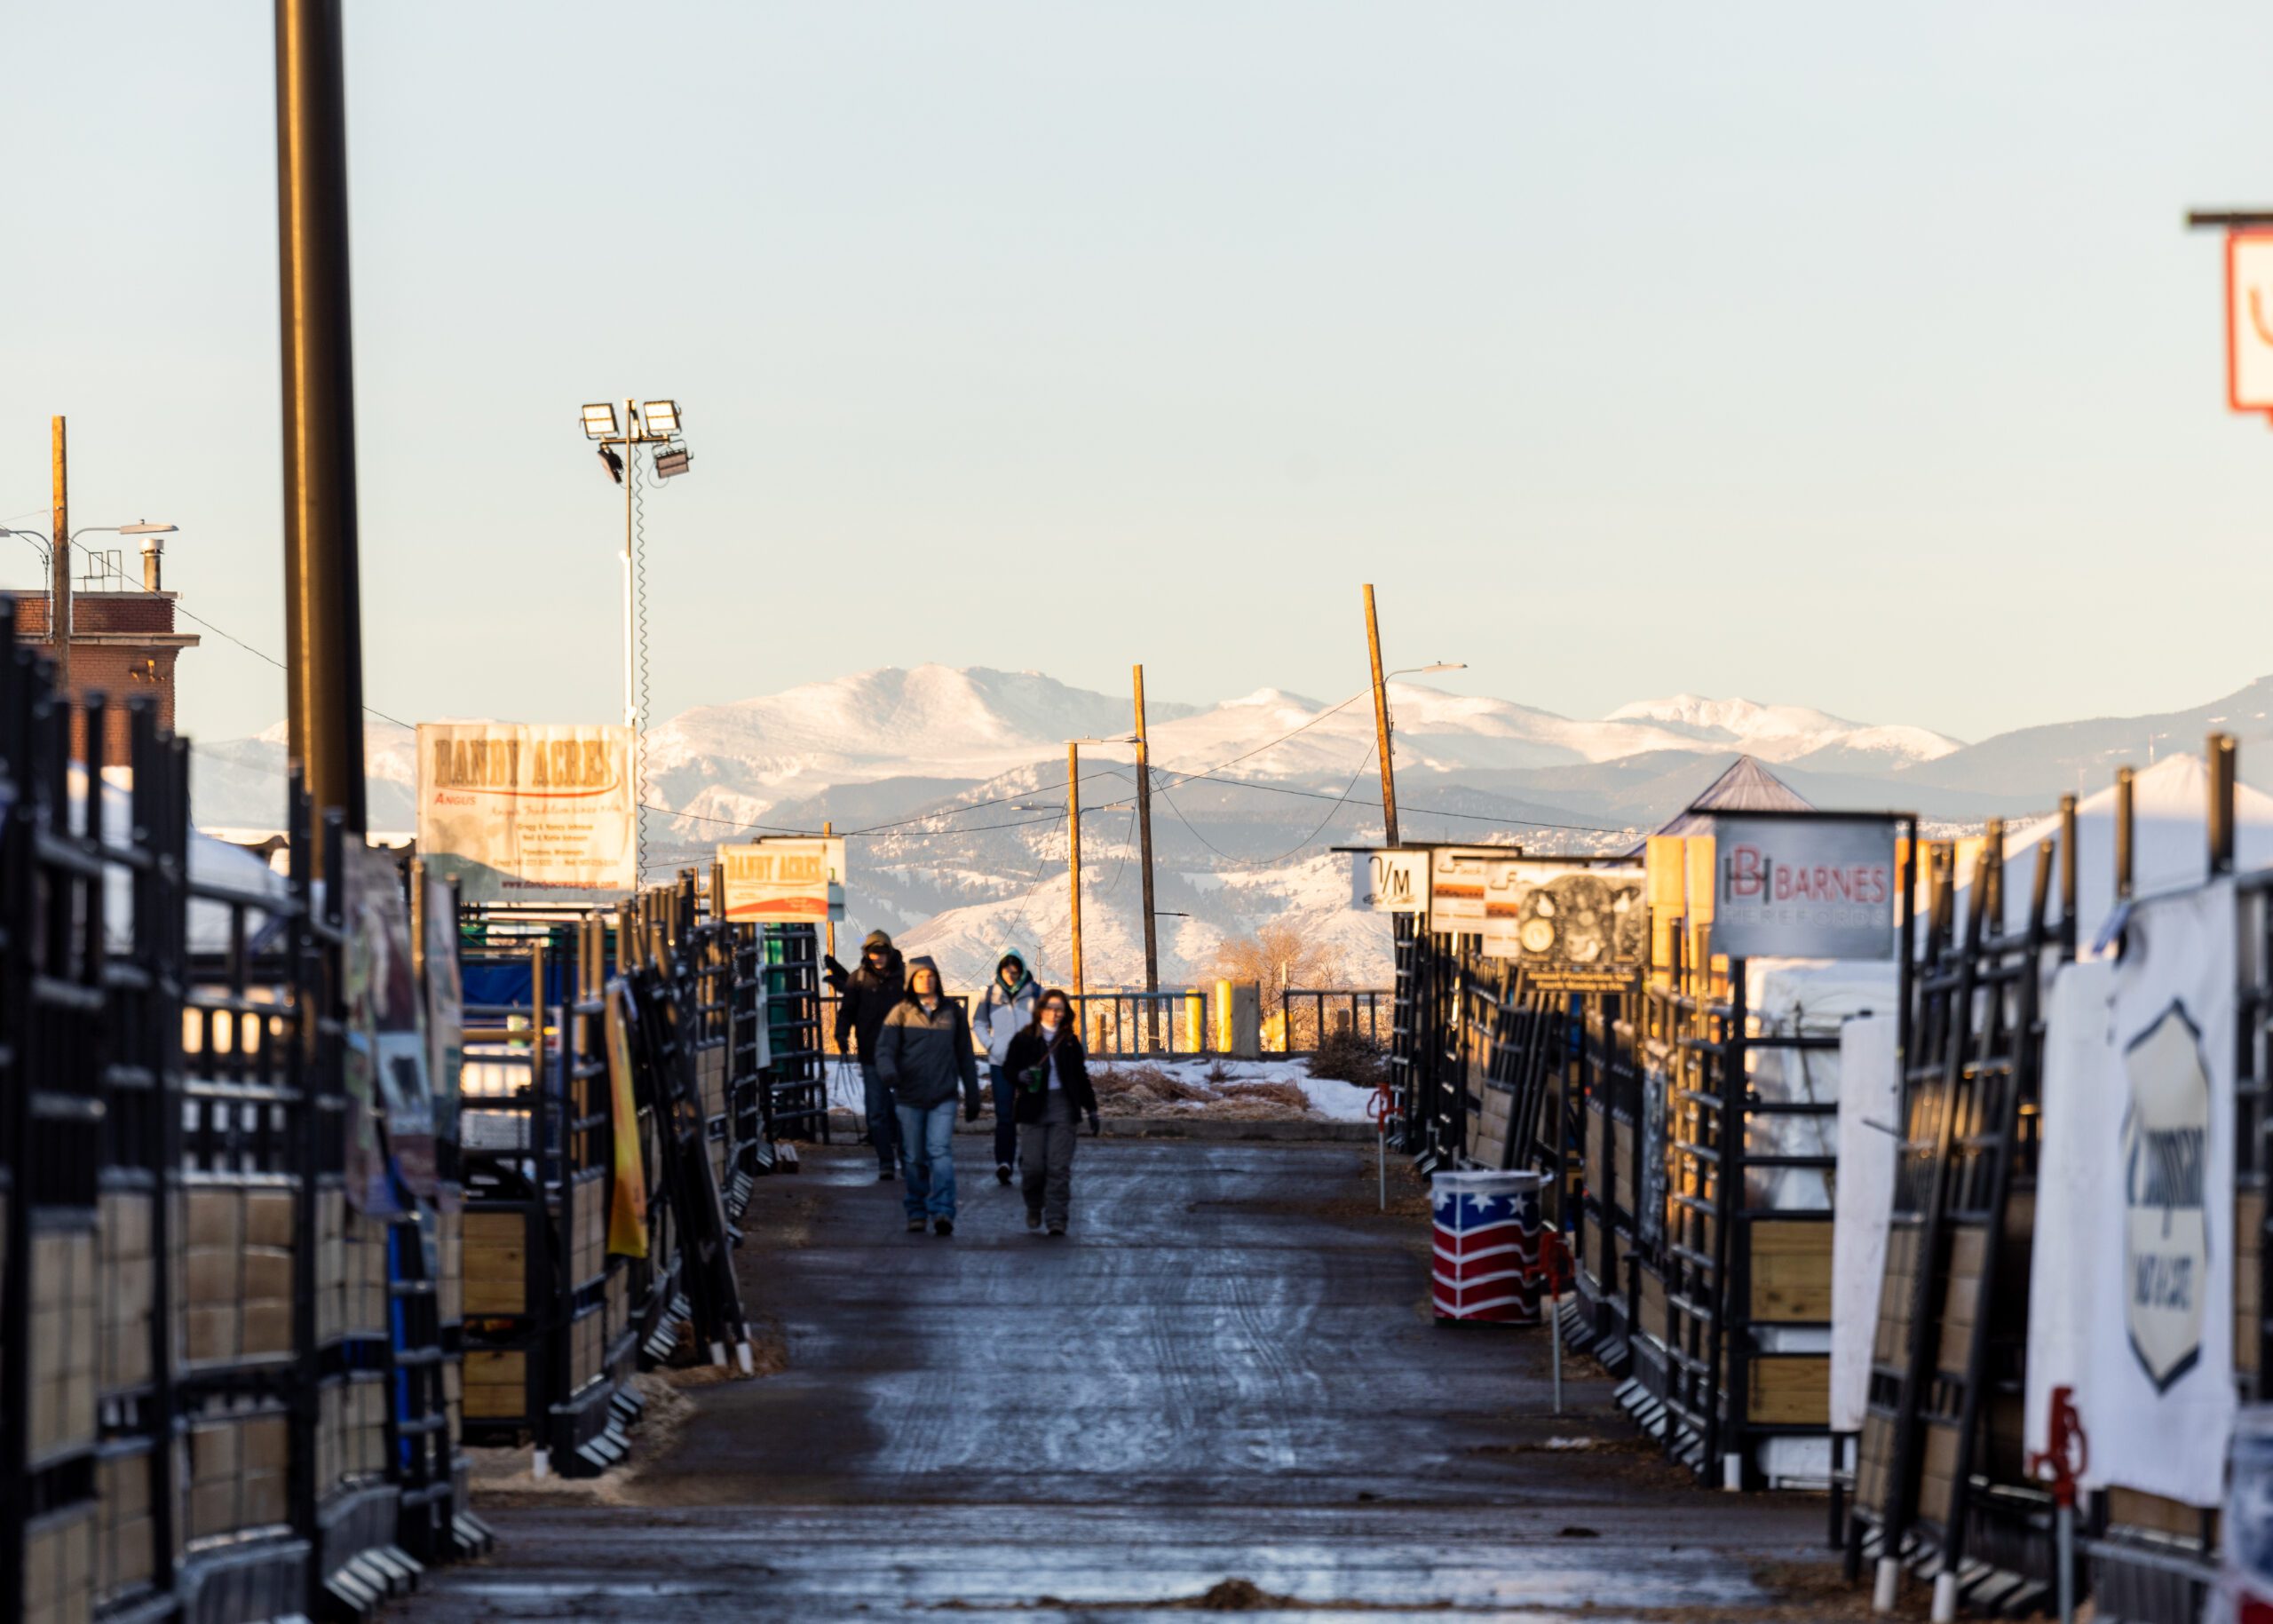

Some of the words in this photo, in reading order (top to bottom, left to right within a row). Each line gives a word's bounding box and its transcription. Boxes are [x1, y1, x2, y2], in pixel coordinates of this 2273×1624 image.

[434, 739, 519, 788] DANDY
[532, 740, 614, 788] ACRES
[433, 792, 477, 805] ANGUS
[727, 855, 773, 880] DANDY
[779, 856, 821, 880] ACRES
[1776, 864, 1887, 904] BARNES
